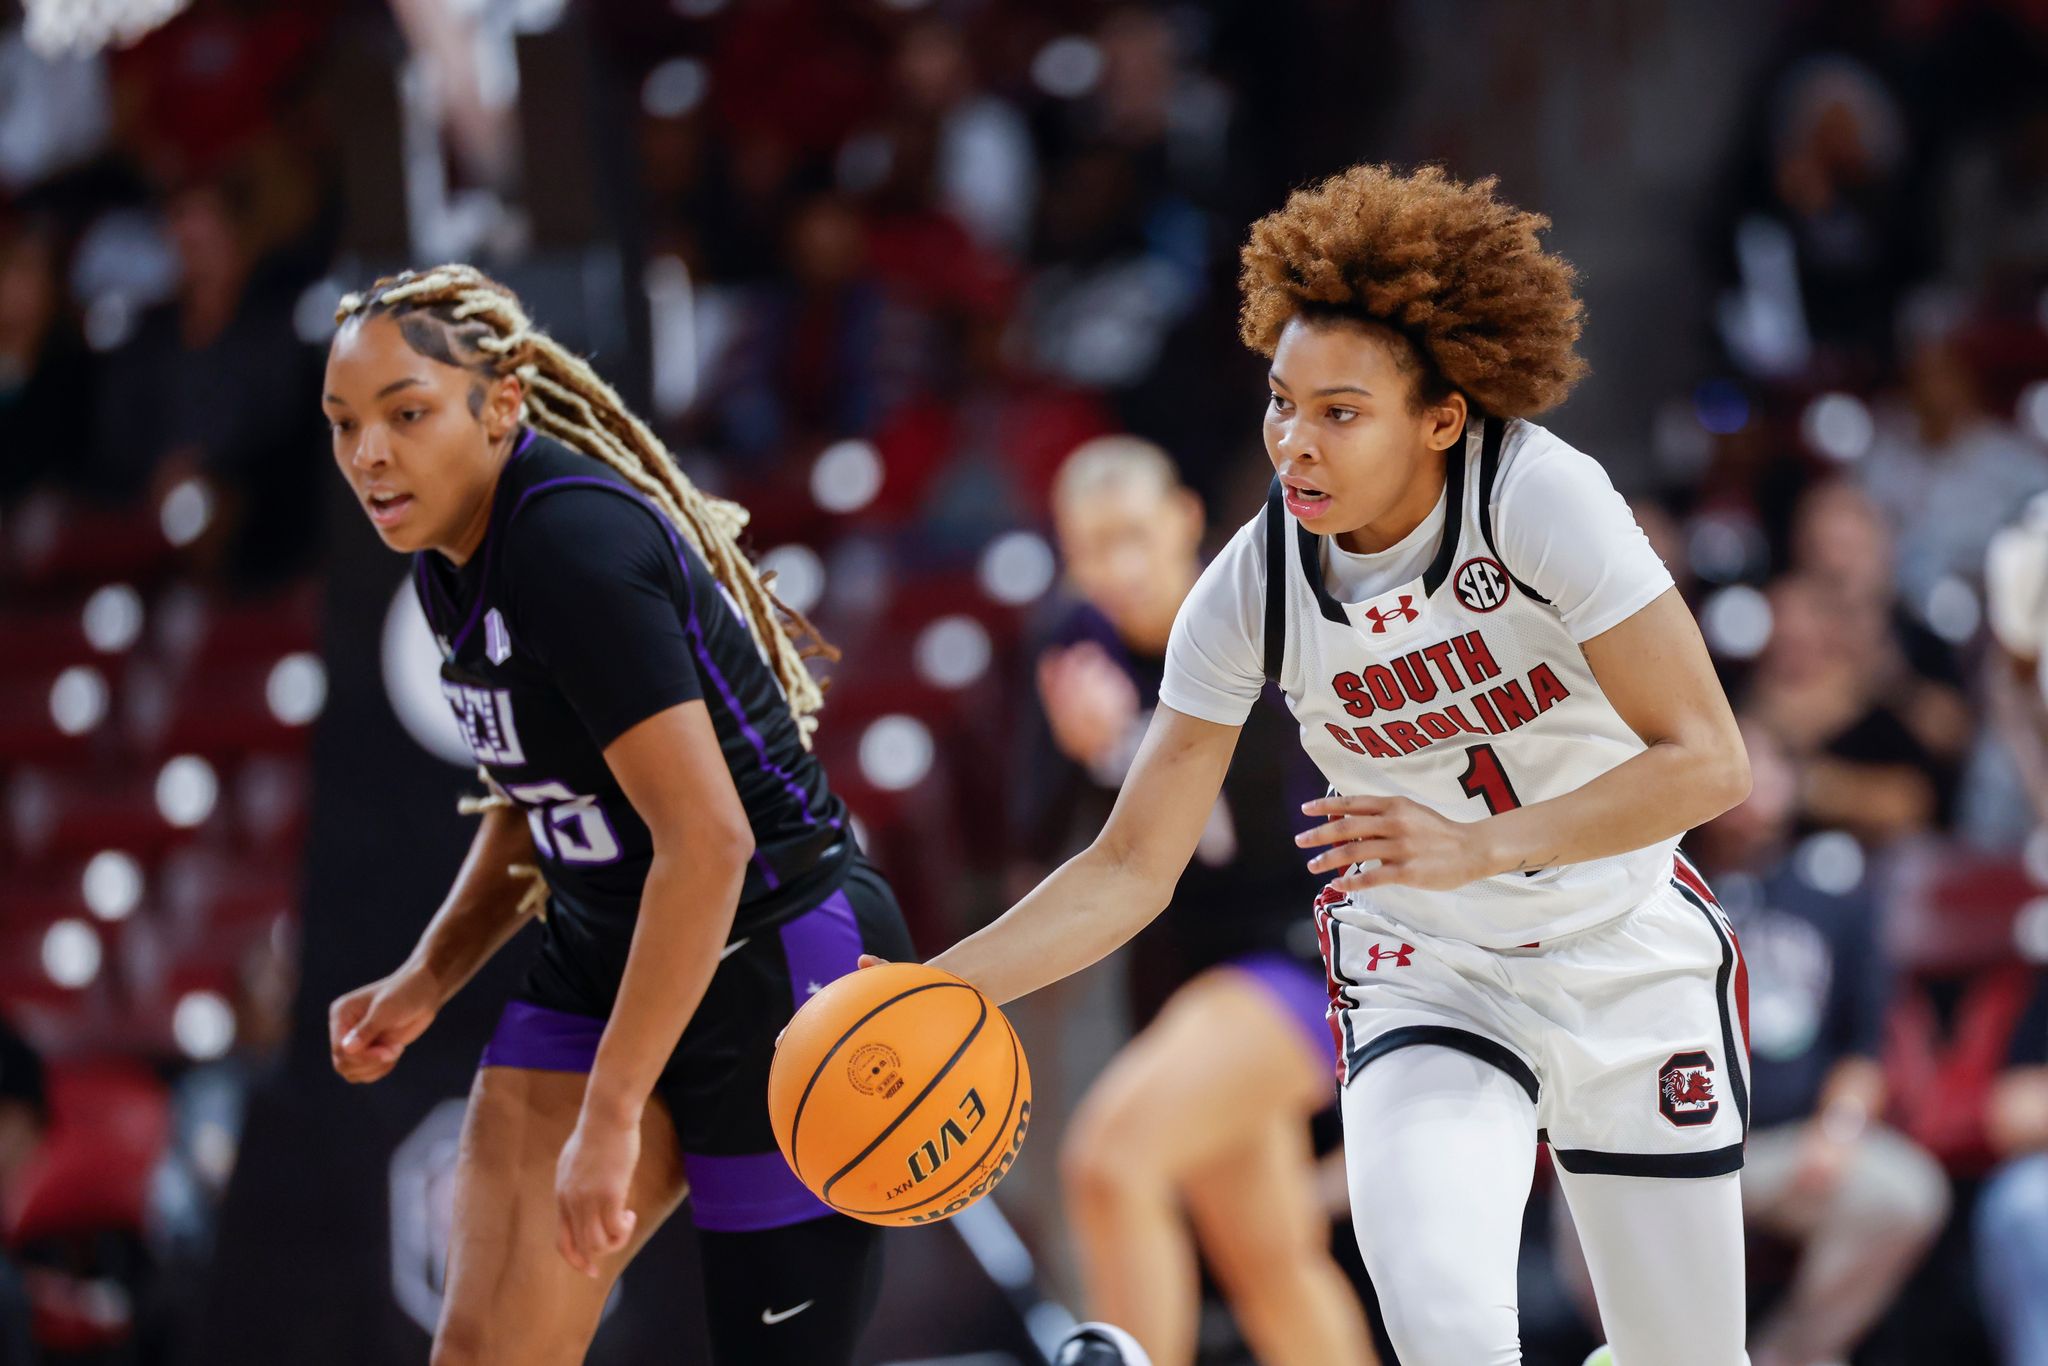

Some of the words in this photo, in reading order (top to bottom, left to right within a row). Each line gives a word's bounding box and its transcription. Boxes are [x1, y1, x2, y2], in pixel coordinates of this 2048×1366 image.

[1458, 561, 1506, 606] SEC
[1324, 662, 1571, 759] CAROLINA
[1332, 630, 1502, 719] SOUTH
[905, 1087, 987, 1184] EVO
[885, 1178, 915, 1201] NXT
